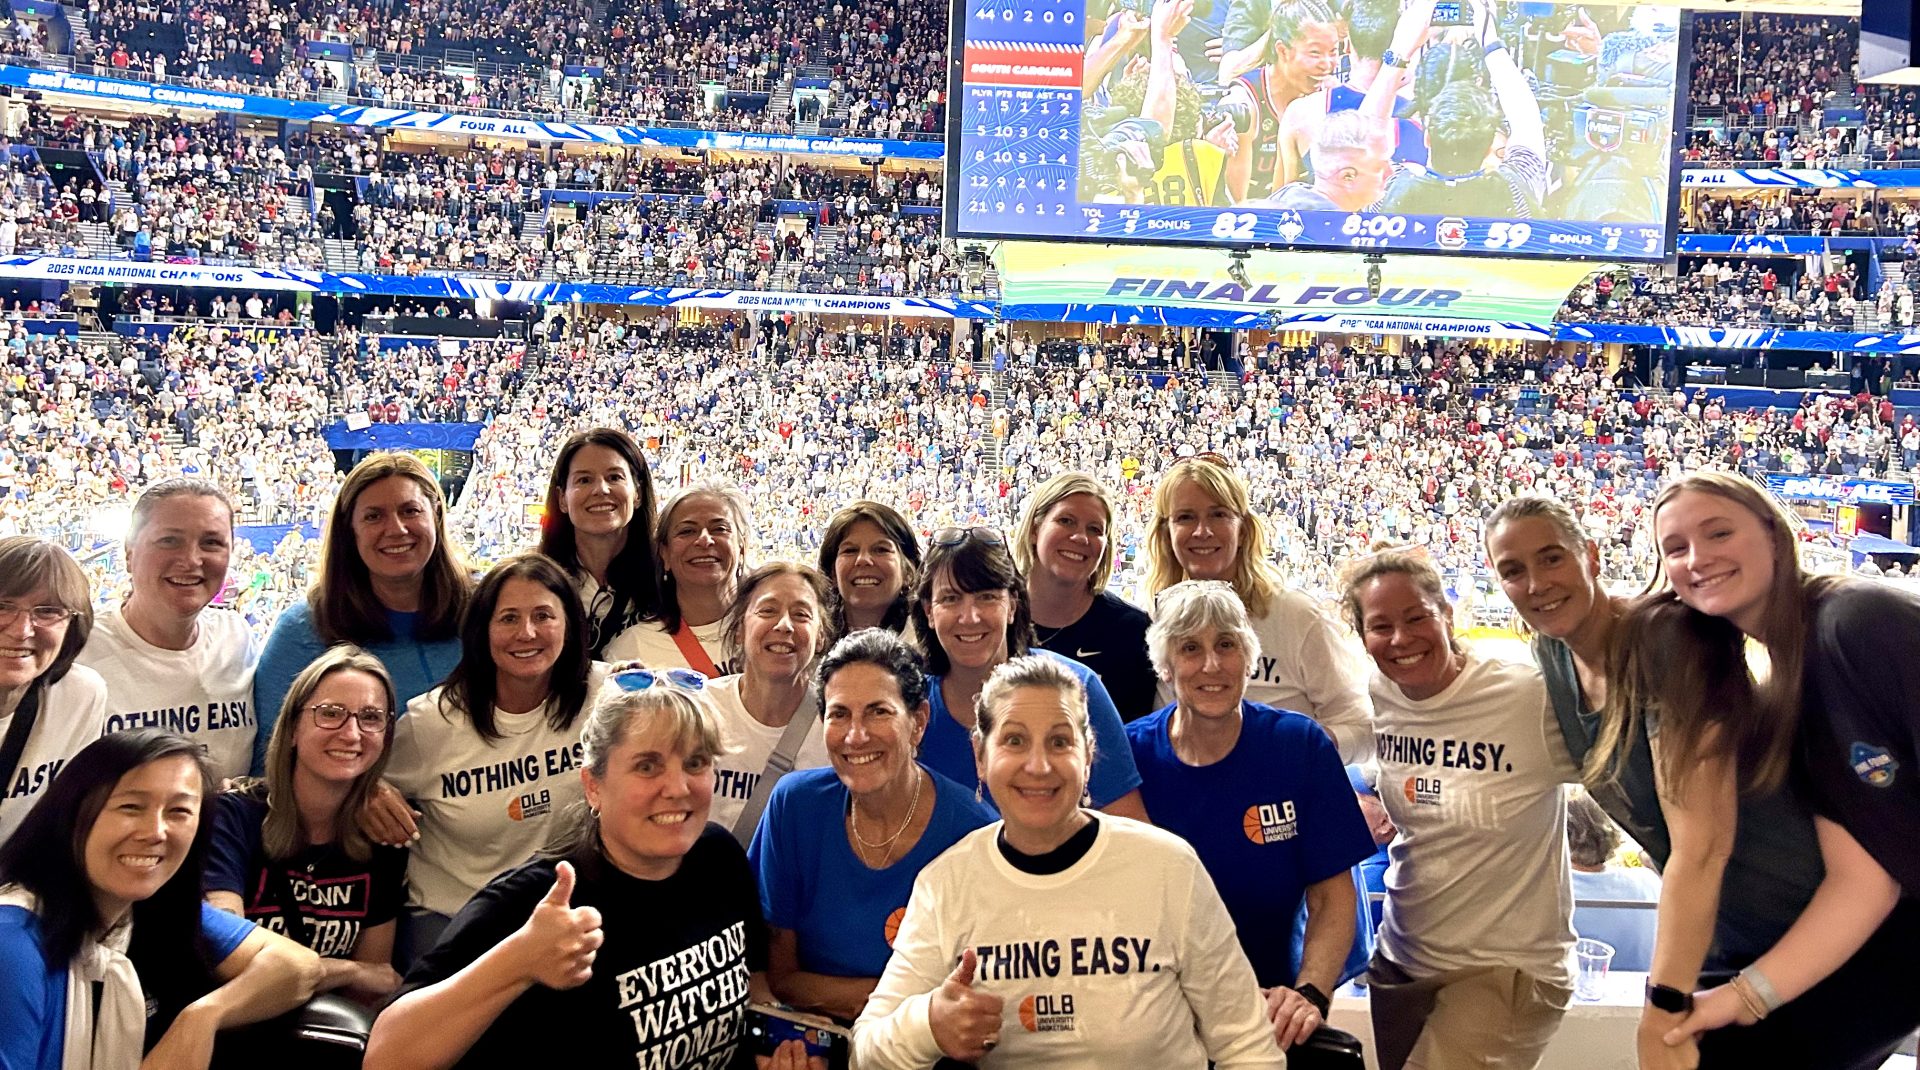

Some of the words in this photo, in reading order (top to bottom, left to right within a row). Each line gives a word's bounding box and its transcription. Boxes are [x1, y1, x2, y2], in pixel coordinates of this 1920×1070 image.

[976, 8, 995, 20] 44
[1003, 9, 1013, 21] 0
[1023, 10, 1033, 21] 2
[1043, 11, 1054, 23] 0
[1063, 12, 1075, 24] 0
[971, 63, 1011, 74] SOUTH
[1012, 65, 1072, 77] CAROLINA
[153, 88, 245, 109] CHAMPIONS
[971, 89, 993, 97] PLYR
[997, 90, 1013, 98] PTS
[978, 100, 986, 111] 1
[1000, 100, 1009, 112] 5
[1020, 101, 1029, 112] 1
[1041, 103, 1049, 114] 1
[1060, 103, 1070, 114] 2
[460, 120, 495, 131] FOUR
[502, 124, 526, 134] ALL
[977, 125, 986, 136] 5
[994, 126, 1013, 137] 10
[1019, 127, 1028, 137] 3
[1038, 128, 1048, 139] 0
[1059, 129, 1068, 140] 2
[811, 139, 883, 153] CHAMPIONS
[975, 150, 985, 161] 8
[993, 151, 1012, 163] 10
[1018, 152, 1027, 163] 5
[1038, 153, 1047, 164] 1
[1057, 154, 1067, 165] 4
[970, 175, 989, 187] 12
[996, 176, 1006, 188] 9
[1017, 177, 1026, 189] 2
[1036, 178, 1046, 190] 4
[1056, 179, 1066, 191] 2
[1701, 175, 1726, 183] ALL
[969, 200, 987, 212] 21
[996, 201, 1005, 213] 9
[1015, 202, 1025, 214] 6
[1036, 203, 1045, 215] 1
[1055, 204, 1065, 215] 2
[1081, 208, 1104, 218] TOL
[1120, 209, 1140, 219] FLS
[1086, 218, 1100, 233] 2
[1124, 219, 1138, 233] 5
[1148, 220, 1191, 230] BONUS
[1211, 212, 1258, 239] 82
[1342, 214, 1407, 237] 8:00
[1601, 227, 1623, 236] FLS
[1484, 222, 1532, 249] 59
[1549, 234, 1592, 245] BONUS
[1639, 228, 1663, 239] TOL
[47, 263, 74, 274] 2025
[77, 265, 104, 276] NCAA
[108, 266, 156, 278] NATIONAL
[160, 270, 244, 282] CHAMONS
[1104, 278, 1282, 304] FINAL
[1296, 286, 1462, 308] FOUR
[737, 295, 760, 305] 2025
[761, 297, 782, 306] NCAA
[784, 297, 822, 307] NATIAL
[824, 299, 891, 310] CHAMPIONS
[1340, 319, 1362, 328] 202
[1386, 321, 1422, 331] NATIONAL
[1425, 323, 1491, 333] CHAMPIONS
[102, 705, 200, 734] OTHING
[208, 702, 253, 730] EASY.
[1443, 740, 1513, 773] EASY.
[441, 755, 540, 798] NOTHING
[1415, 778, 1441, 795] OLB
[521, 789, 551, 809] OLB
[1259, 800, 1296, 826] OLB
[290, 879, 355, 907] CONN
[958, 939, 1061, 981] THING
[1070, 936, 1160, 976] EASY.
[1036, 994, 1074, 1015] OLB
